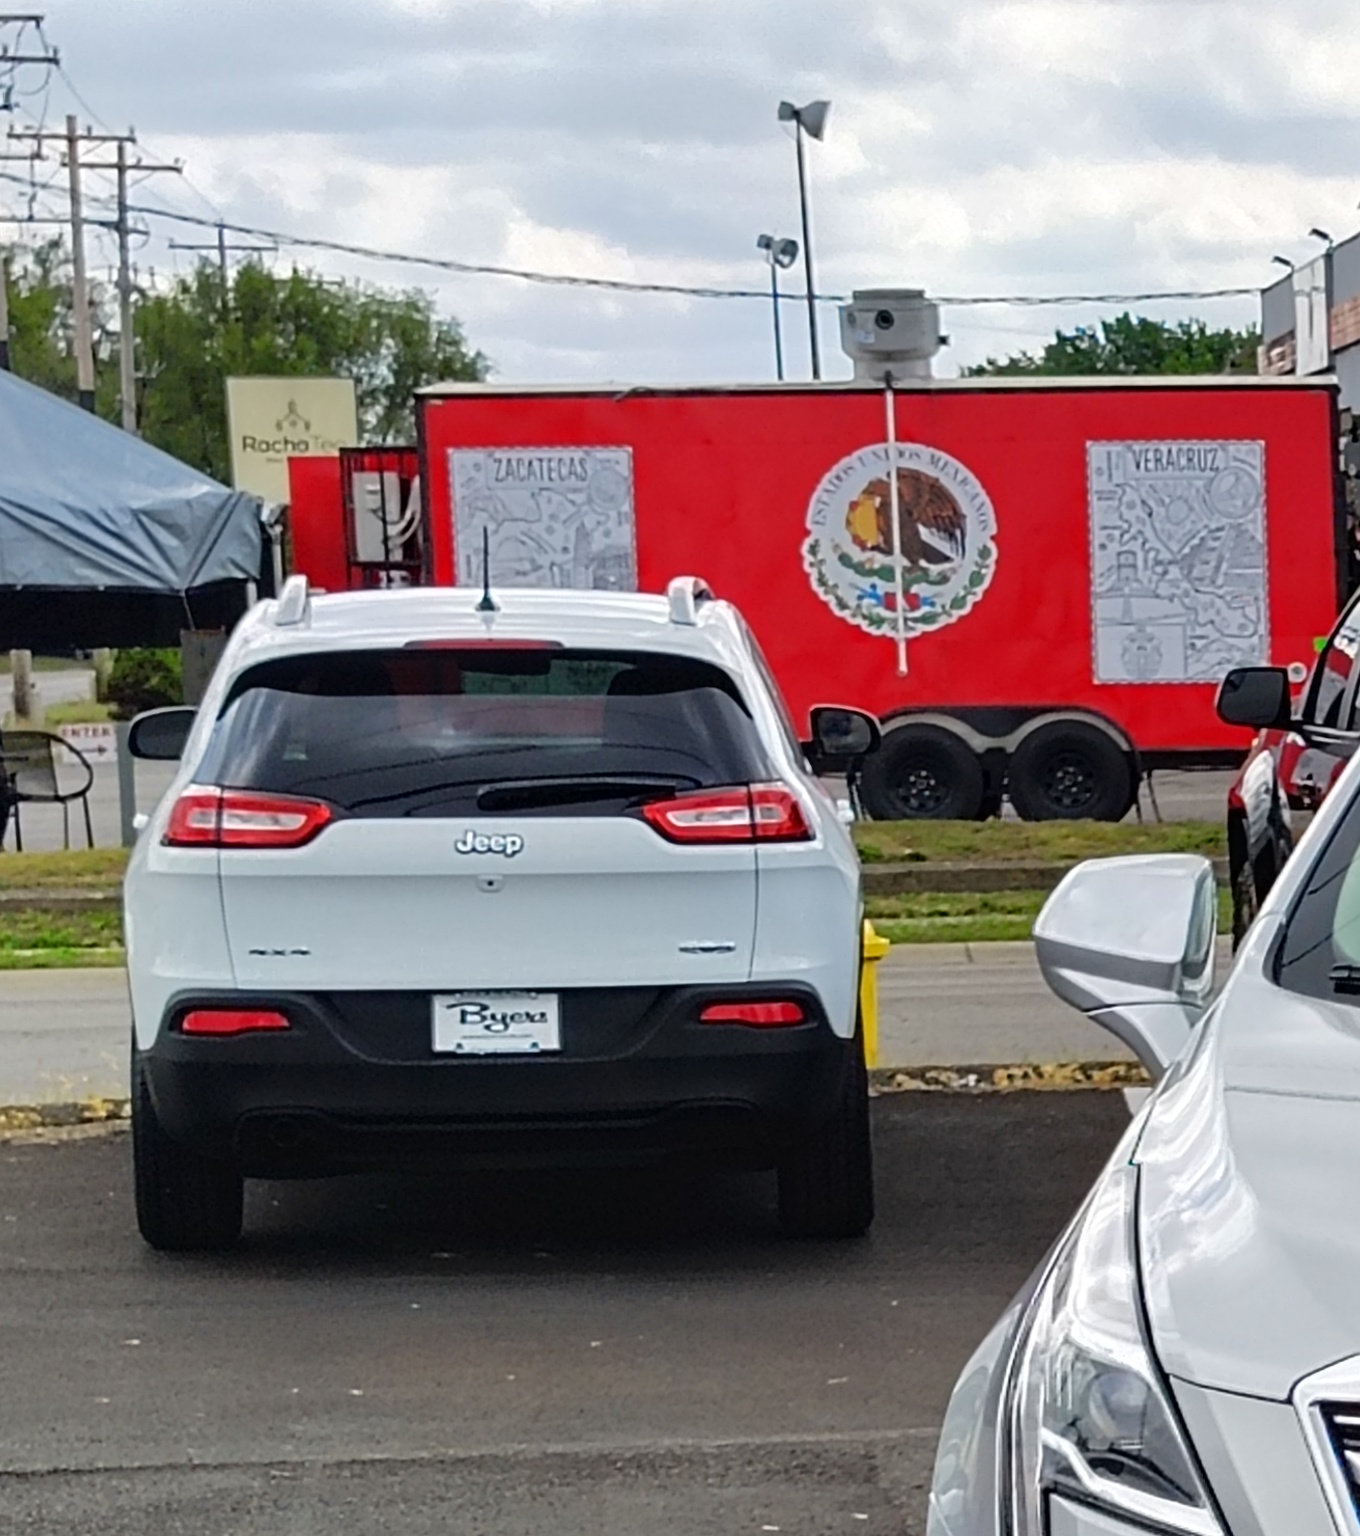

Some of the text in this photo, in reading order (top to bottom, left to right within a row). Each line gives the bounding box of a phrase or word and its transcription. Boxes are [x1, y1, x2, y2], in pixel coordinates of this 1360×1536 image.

[493, 457, 589, 483] ZACATECAS
[1132, 447, 1220, 473] VERACRUZ
[61, 726, 111, 737] ENTER
[455, 829, 524, 858] Jeep
